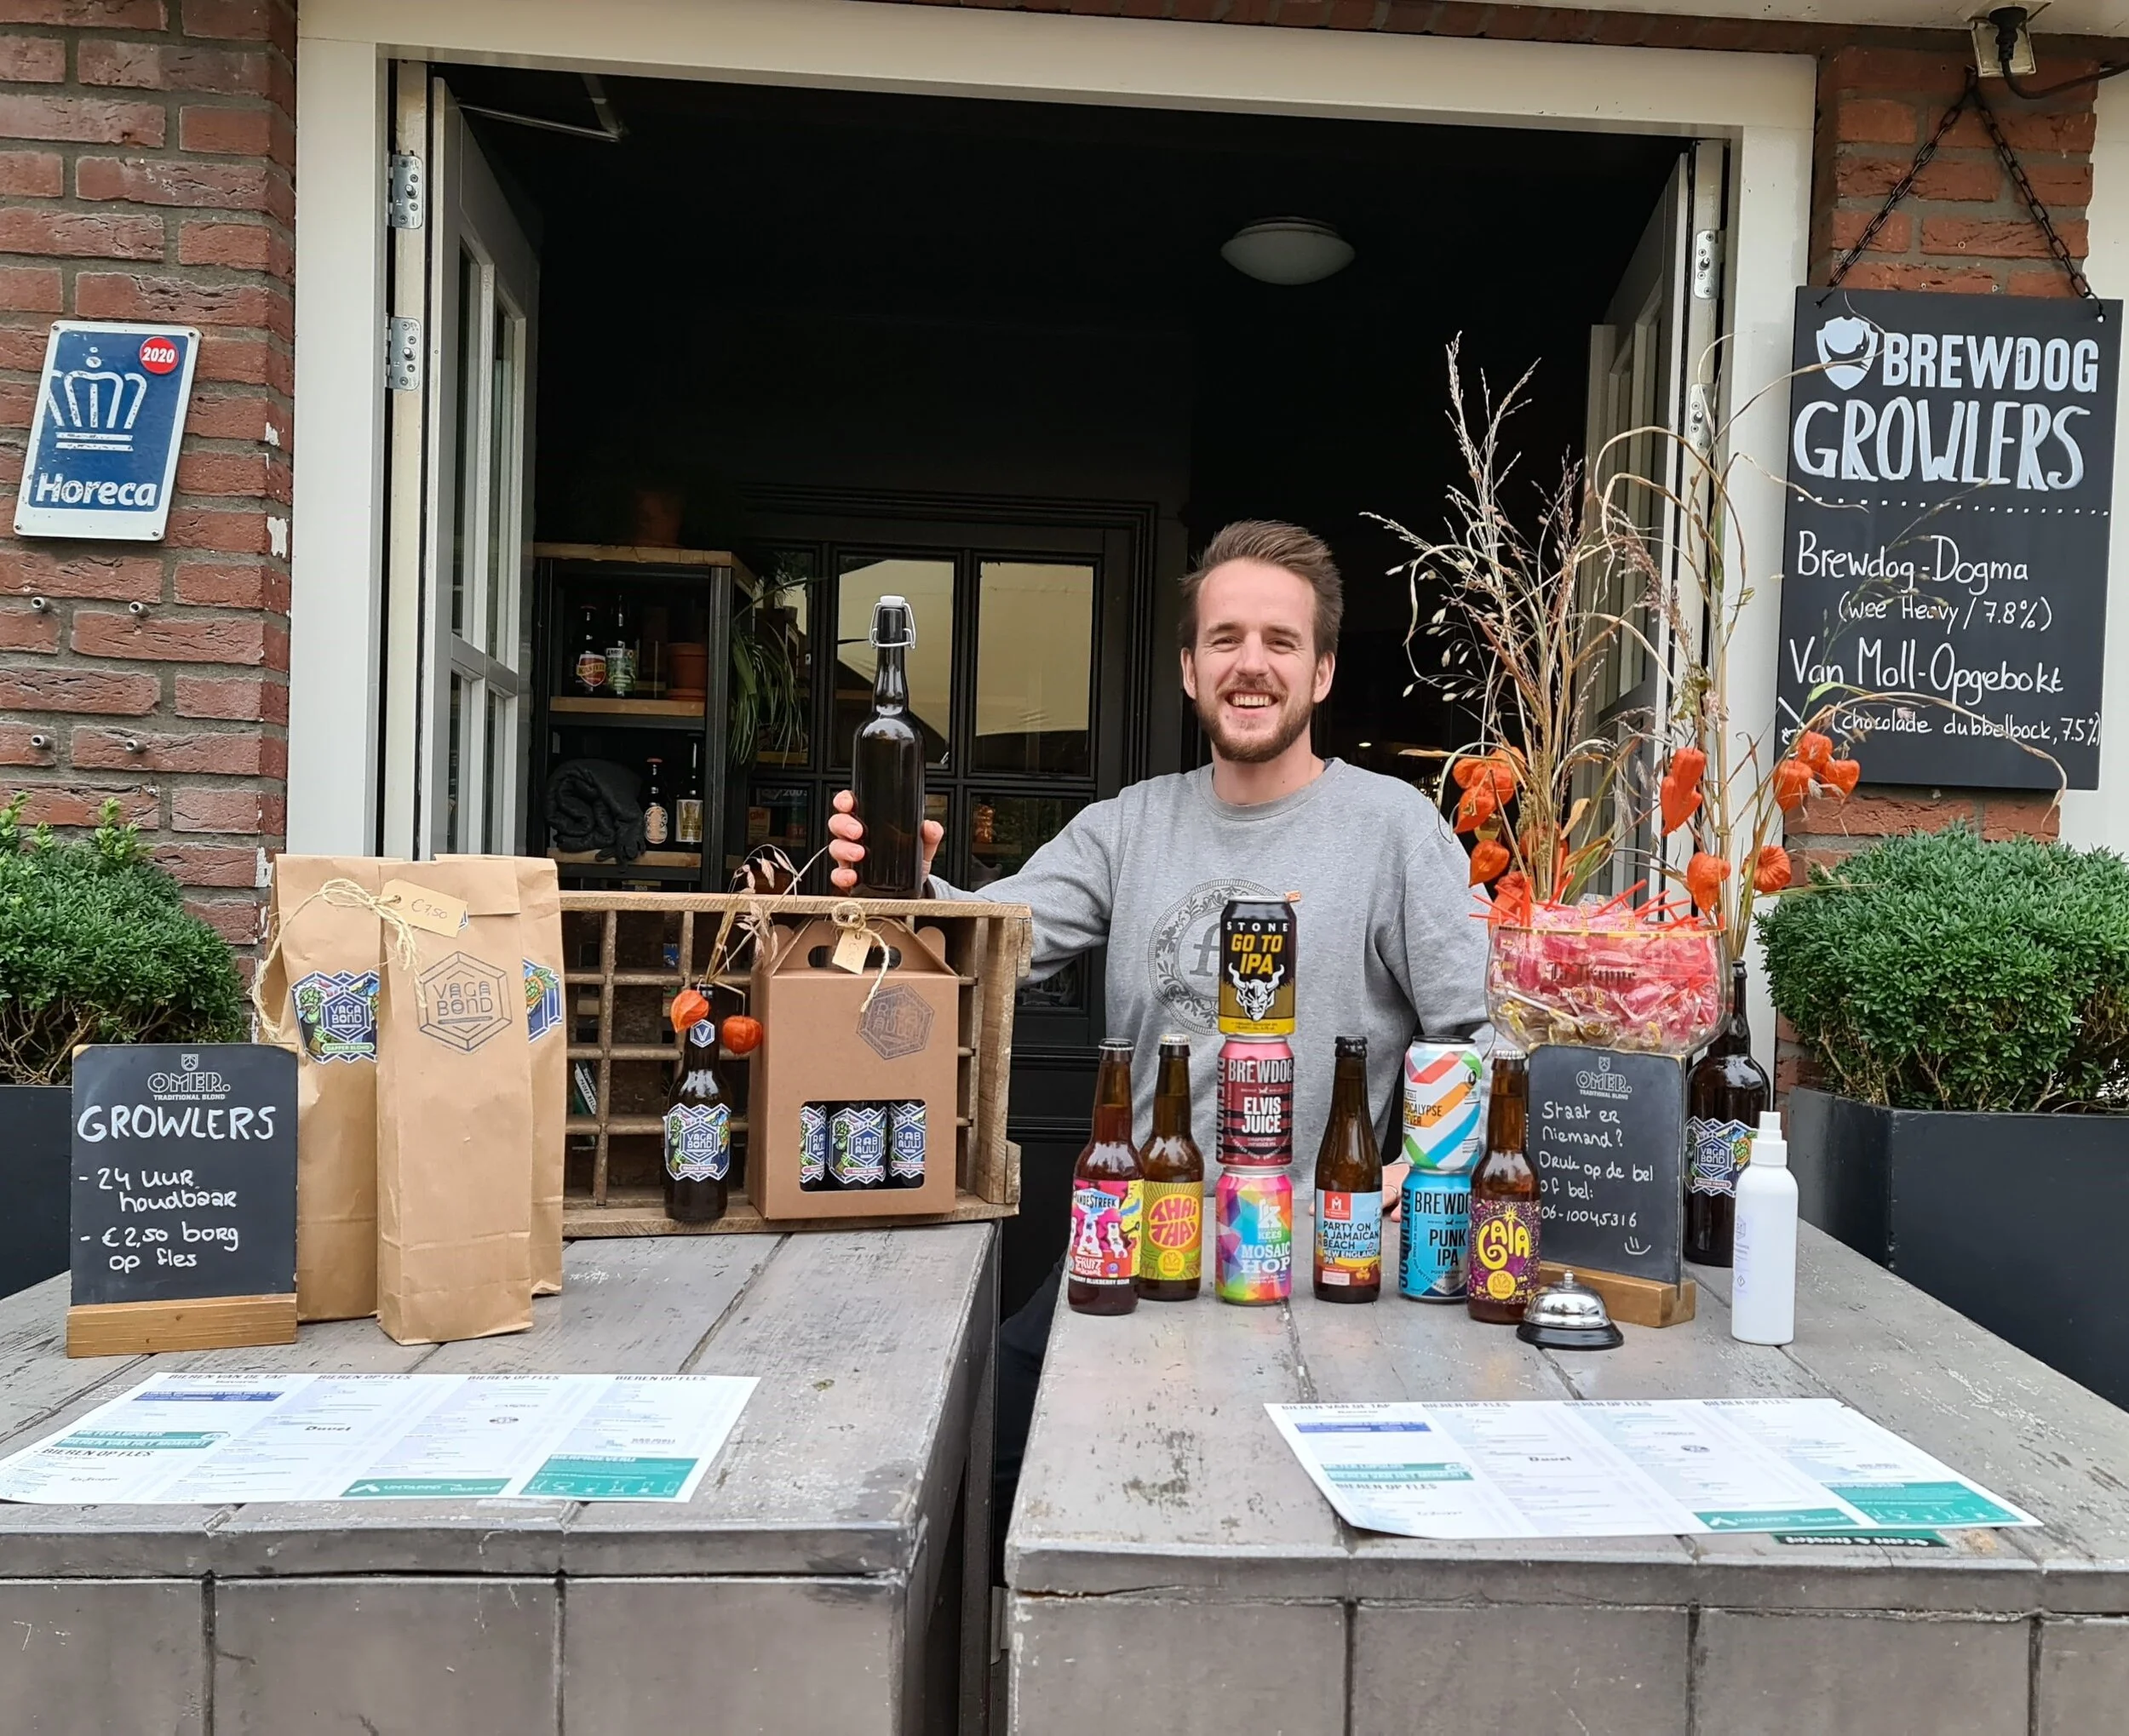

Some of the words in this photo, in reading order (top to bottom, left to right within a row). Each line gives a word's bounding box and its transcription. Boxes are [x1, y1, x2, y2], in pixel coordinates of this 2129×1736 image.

[141, 347, 175, 364] 2020
[1882, 333, 2099, 393] BREWDOG
[1793, 395, 2091, 492] GROWLERS
[35, 473, 158, 507] Horeca
[1790, 636, 1844, 685] Van
[1226, 921, 1288, 932] STONE
[1231, 934, 1255, 953] GO
[1261, 934, 1283, 953] TO
[1239, 954, 1274, 975] IPA
[433, 980, 491, 1000] VAGA
[330, 1005, 361, 1014] VAGA
[695, 1028, 709, 1042] V
[1229, 1059, 1292, 1083] BREWDOG
[1580, 1089, 1610, 1098] TRADITIONAL
[1244, 1097, 1282, 1115] ELVIS
[1542, 1101, 1591, 1120] Staat
[77, 1104, 277, 1143] GROWLERS
[1242, 1115, 1282, 1134] JUICE
[686, 1133, 713, 1142] VAGA
[855, 1137, 877, 1146] RAB
[898, 1132, 921, 1140] RAB
[1701, 1147, 1724, 1156] VAGA
[97, 1167, 130, 1191] 24
[1584, 1164, 1601, 1179] op
[1606, 1161, 1625, 1178] de
[1633, 1164, 1653, 1183] bel
[1415, 1192, 1471, 1215] BREWDO
[1541, 1204, 1637, 1227] 06-10045316
[1323, 1221, 1353, 1231] PARTY
[1357, 1223, 1371, 1232] ON
[1323, 1229, 1328, 1239] A
[1331, 1231, 1379, 1240] JAMAICAN
[182, 1222, 238, 1251] borg
[1323, 1239, 1355, 1249] BEACH
[1429, 1228, 1466, 1246] PUNK
[1478, 1218, 1530, 1270] GAIA
[1241, 1241, 1290, 1259] MOSAIC
[1340, 1250, 1376, 1258] ENGLAND
[1437, 1249, 1459, 1266] IPA
[109, 1255, 141, 1274] op
[157, 1248, 197, 1268] fles
[1240, 1256, 1290, 1274] HOP
